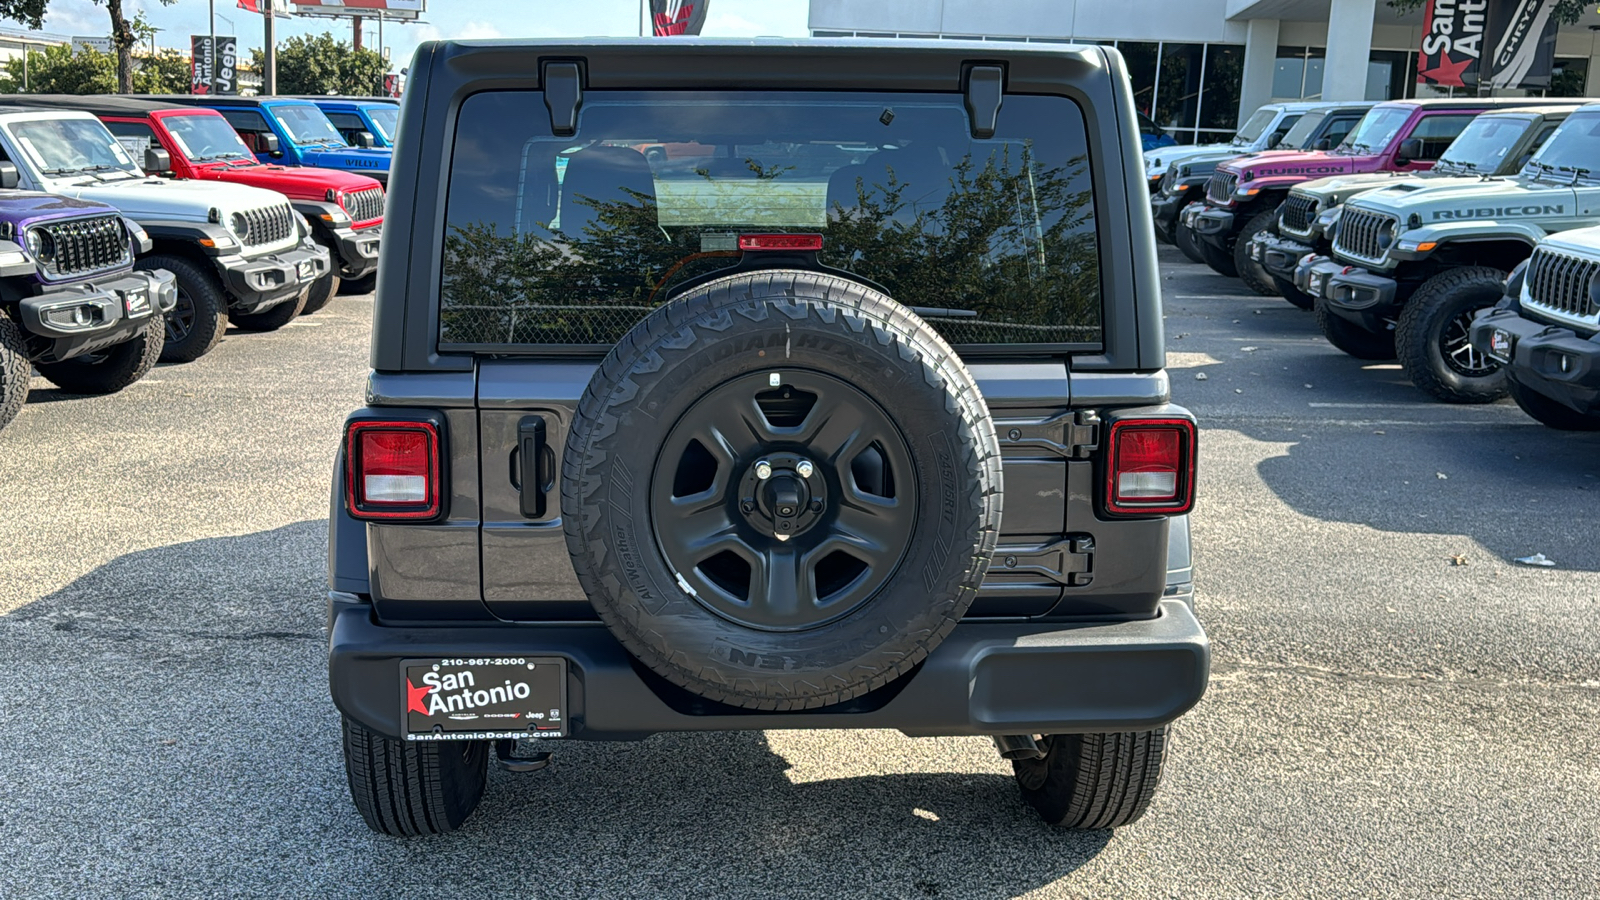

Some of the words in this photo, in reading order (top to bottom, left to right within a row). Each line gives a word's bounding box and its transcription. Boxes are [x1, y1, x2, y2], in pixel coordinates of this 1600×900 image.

[202, 38, 212, 85] Antonio
[215, 43, 236, 91] Jeep
[193, 63, 202, 84] San
[345, 159, 379, 168] WILLYS
[1260, 166, 1344, 175] RUBICON
[1432, 204, 1564, 220] RUBICON
[938, 452, 955, 525] 245/75R17
[614, 524, 653, 600] All-Weather
[441, 658, 526, 666] 210-967-2000
[422, 670, 475, 693] San
[429, 680, 531, 716] Antonio
[525, 711, 545, 720] Jeep
[407, 731, 562, 741] SanAntonioDodge.com
